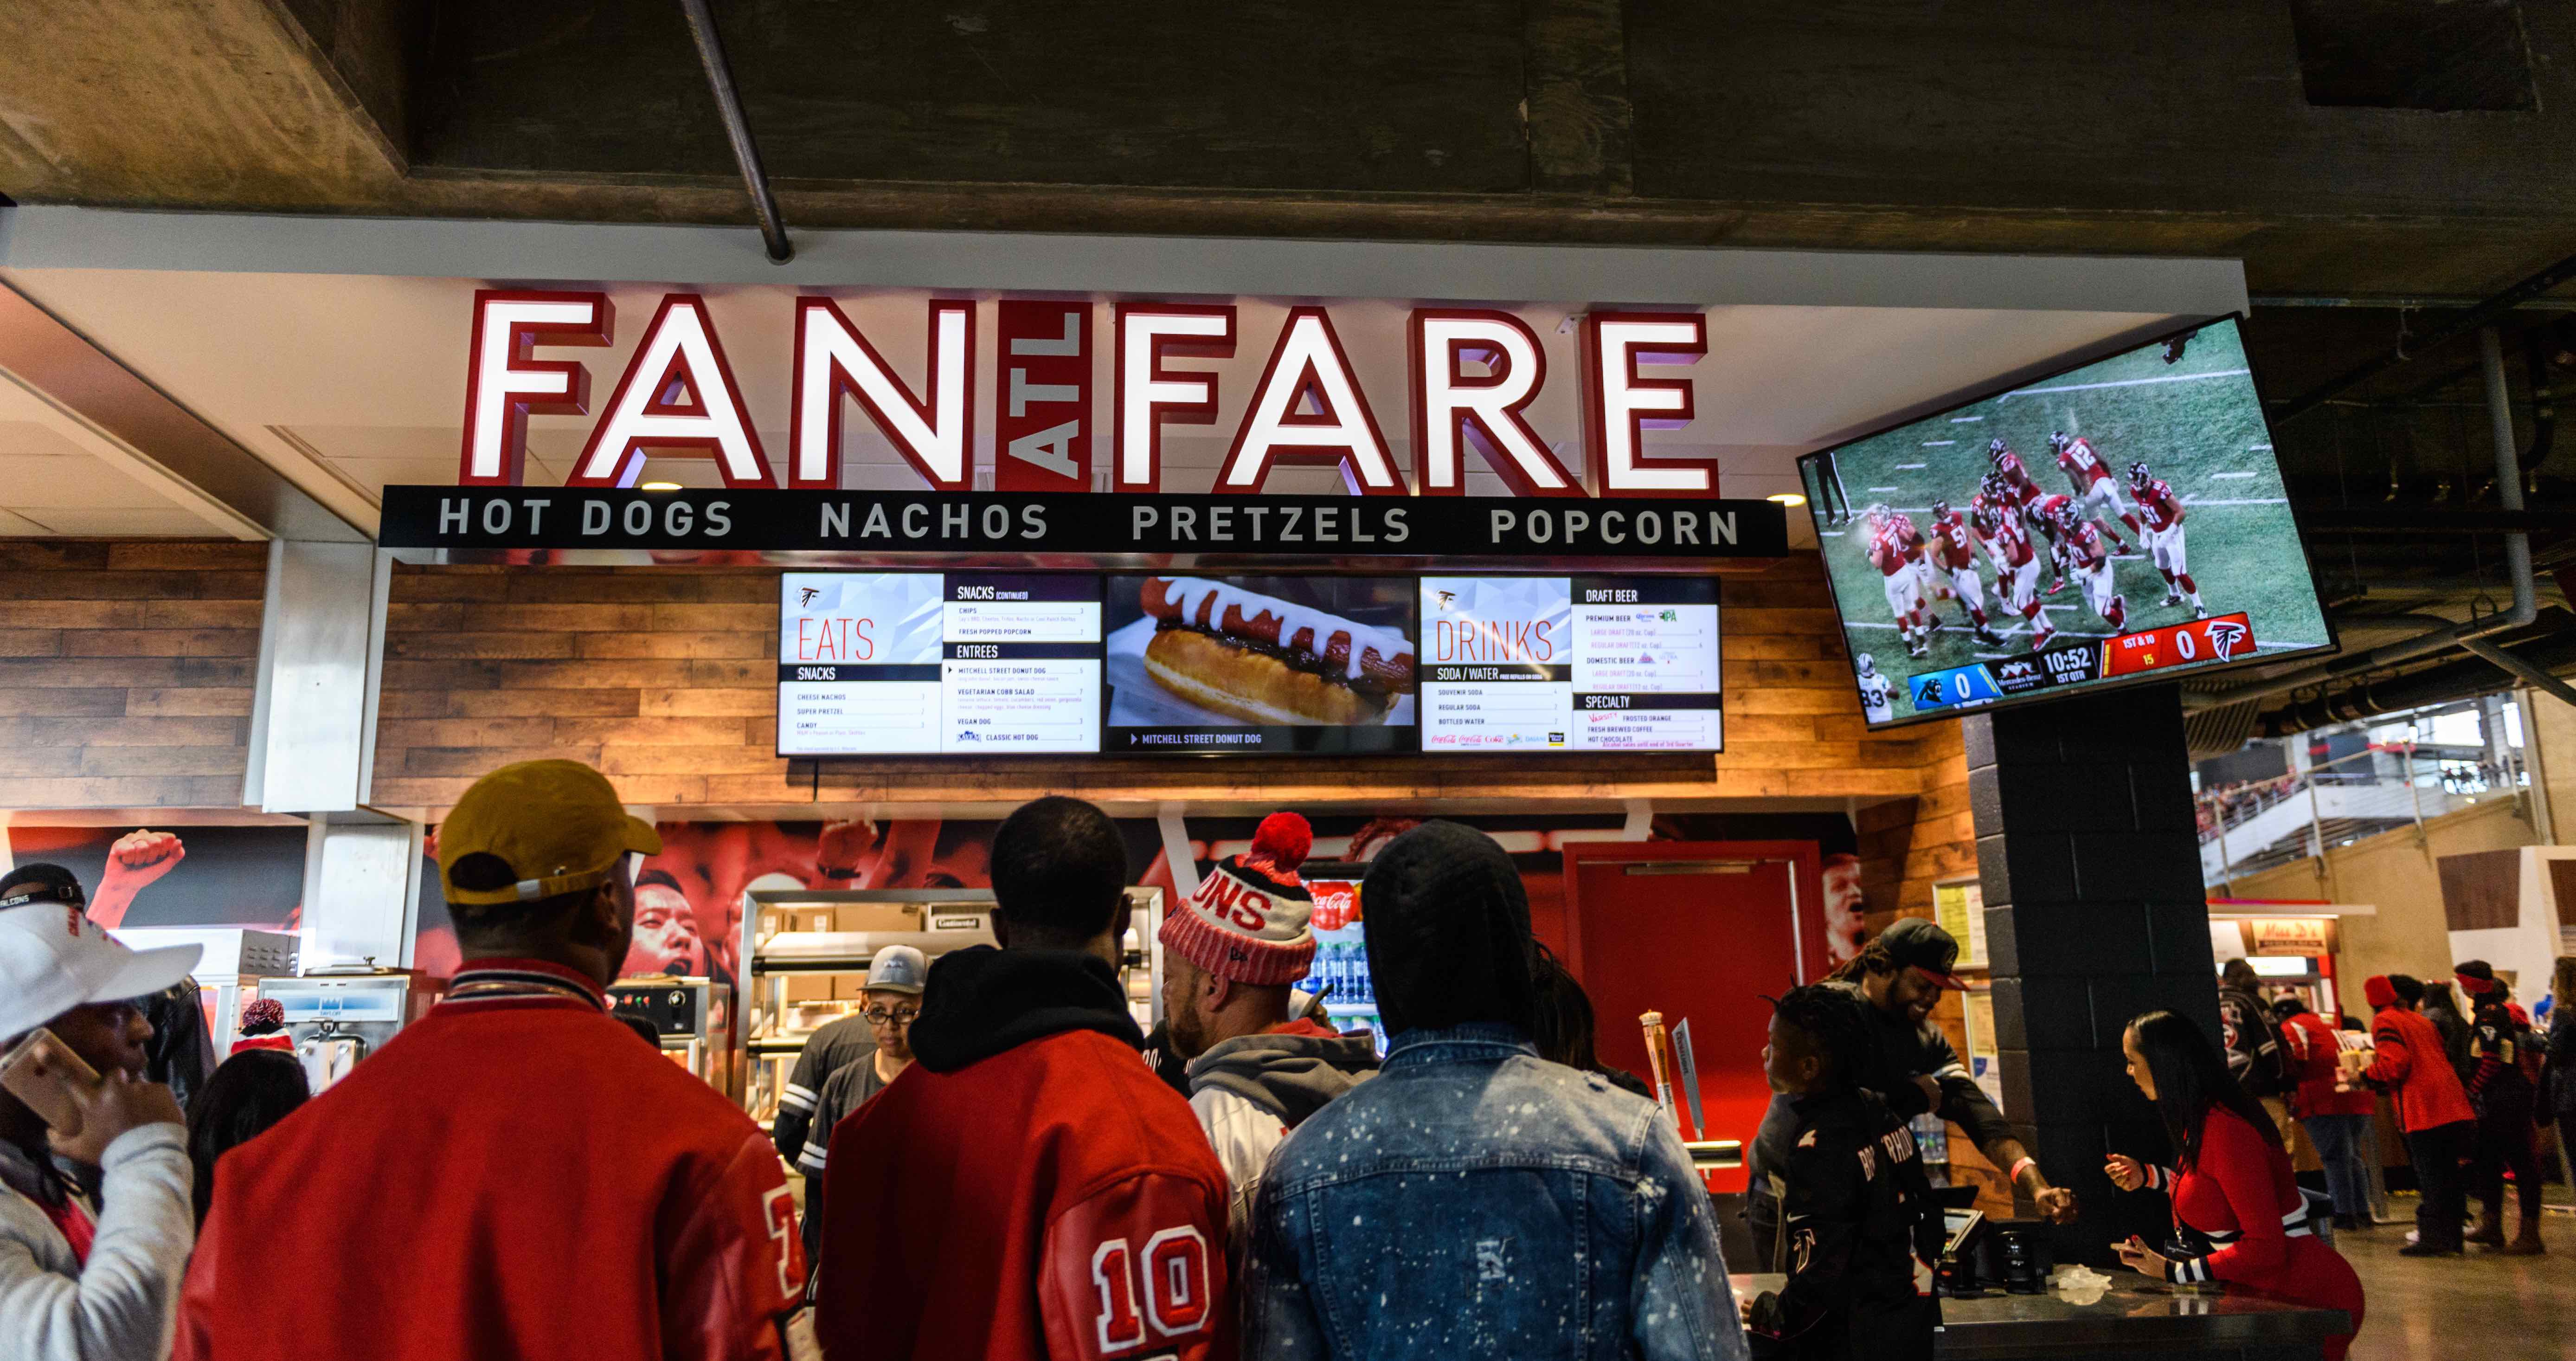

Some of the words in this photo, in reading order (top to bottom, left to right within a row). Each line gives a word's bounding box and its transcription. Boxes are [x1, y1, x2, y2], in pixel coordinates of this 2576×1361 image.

[461, 291, 975, 488] FAN
[1009, 312, 1080, 480] ATL
[1117, 305, 1717, 496] FARE
[2071, 444, 2096, 471] 12
[439, 497, 550, 535] HOT
[582, 499, 732, 536] DOGS
[821, 502, 1048, 539] NACHOS
[1133, 506, 1410, 543] PRETZELS
[1492, 509, 1738, 546] POPCORN
[957, 586, 995, 600] SNACKS
[1586, 589, 1613, 602] DRAFT
[1615, 589, 1638, 602] BEER
[799, 618, 874, 660] EATS
[957, 645, 998, 658] ENTREES
[1438, 620, 1552, 661] DRINKS
[2138, 636, 2146, 646] &
[2145, 634, 2155, 645] 10
[2176, 630, 2196, 660] 0
[2044, 647, 2092, 674] 10:52
[2143, 653, 2154, 665] 15
[798, 666, 835, 680] SNACKS
[1437, 667, 1461, 680] SODA
[1469, 667, 1499, 680] WATER
[1955, 673, 1971, 699] 0
[1998, 674, 2041, 686] Mercedes-Benz
[2069, 670, 2086, 682] QTR
[1586, 696, 1630, 709] SPECIALTY
[1860, 689, 1885, 707] 83
[1142, 734, 1182, 743] MITCHELL
[1184, 734, 1214, 743] STREET
[1215, 734, 1243, 743] DONUT
[1245, 734, 1261, 743] DOG
[1092, 1224, 1211, 1354] 10
